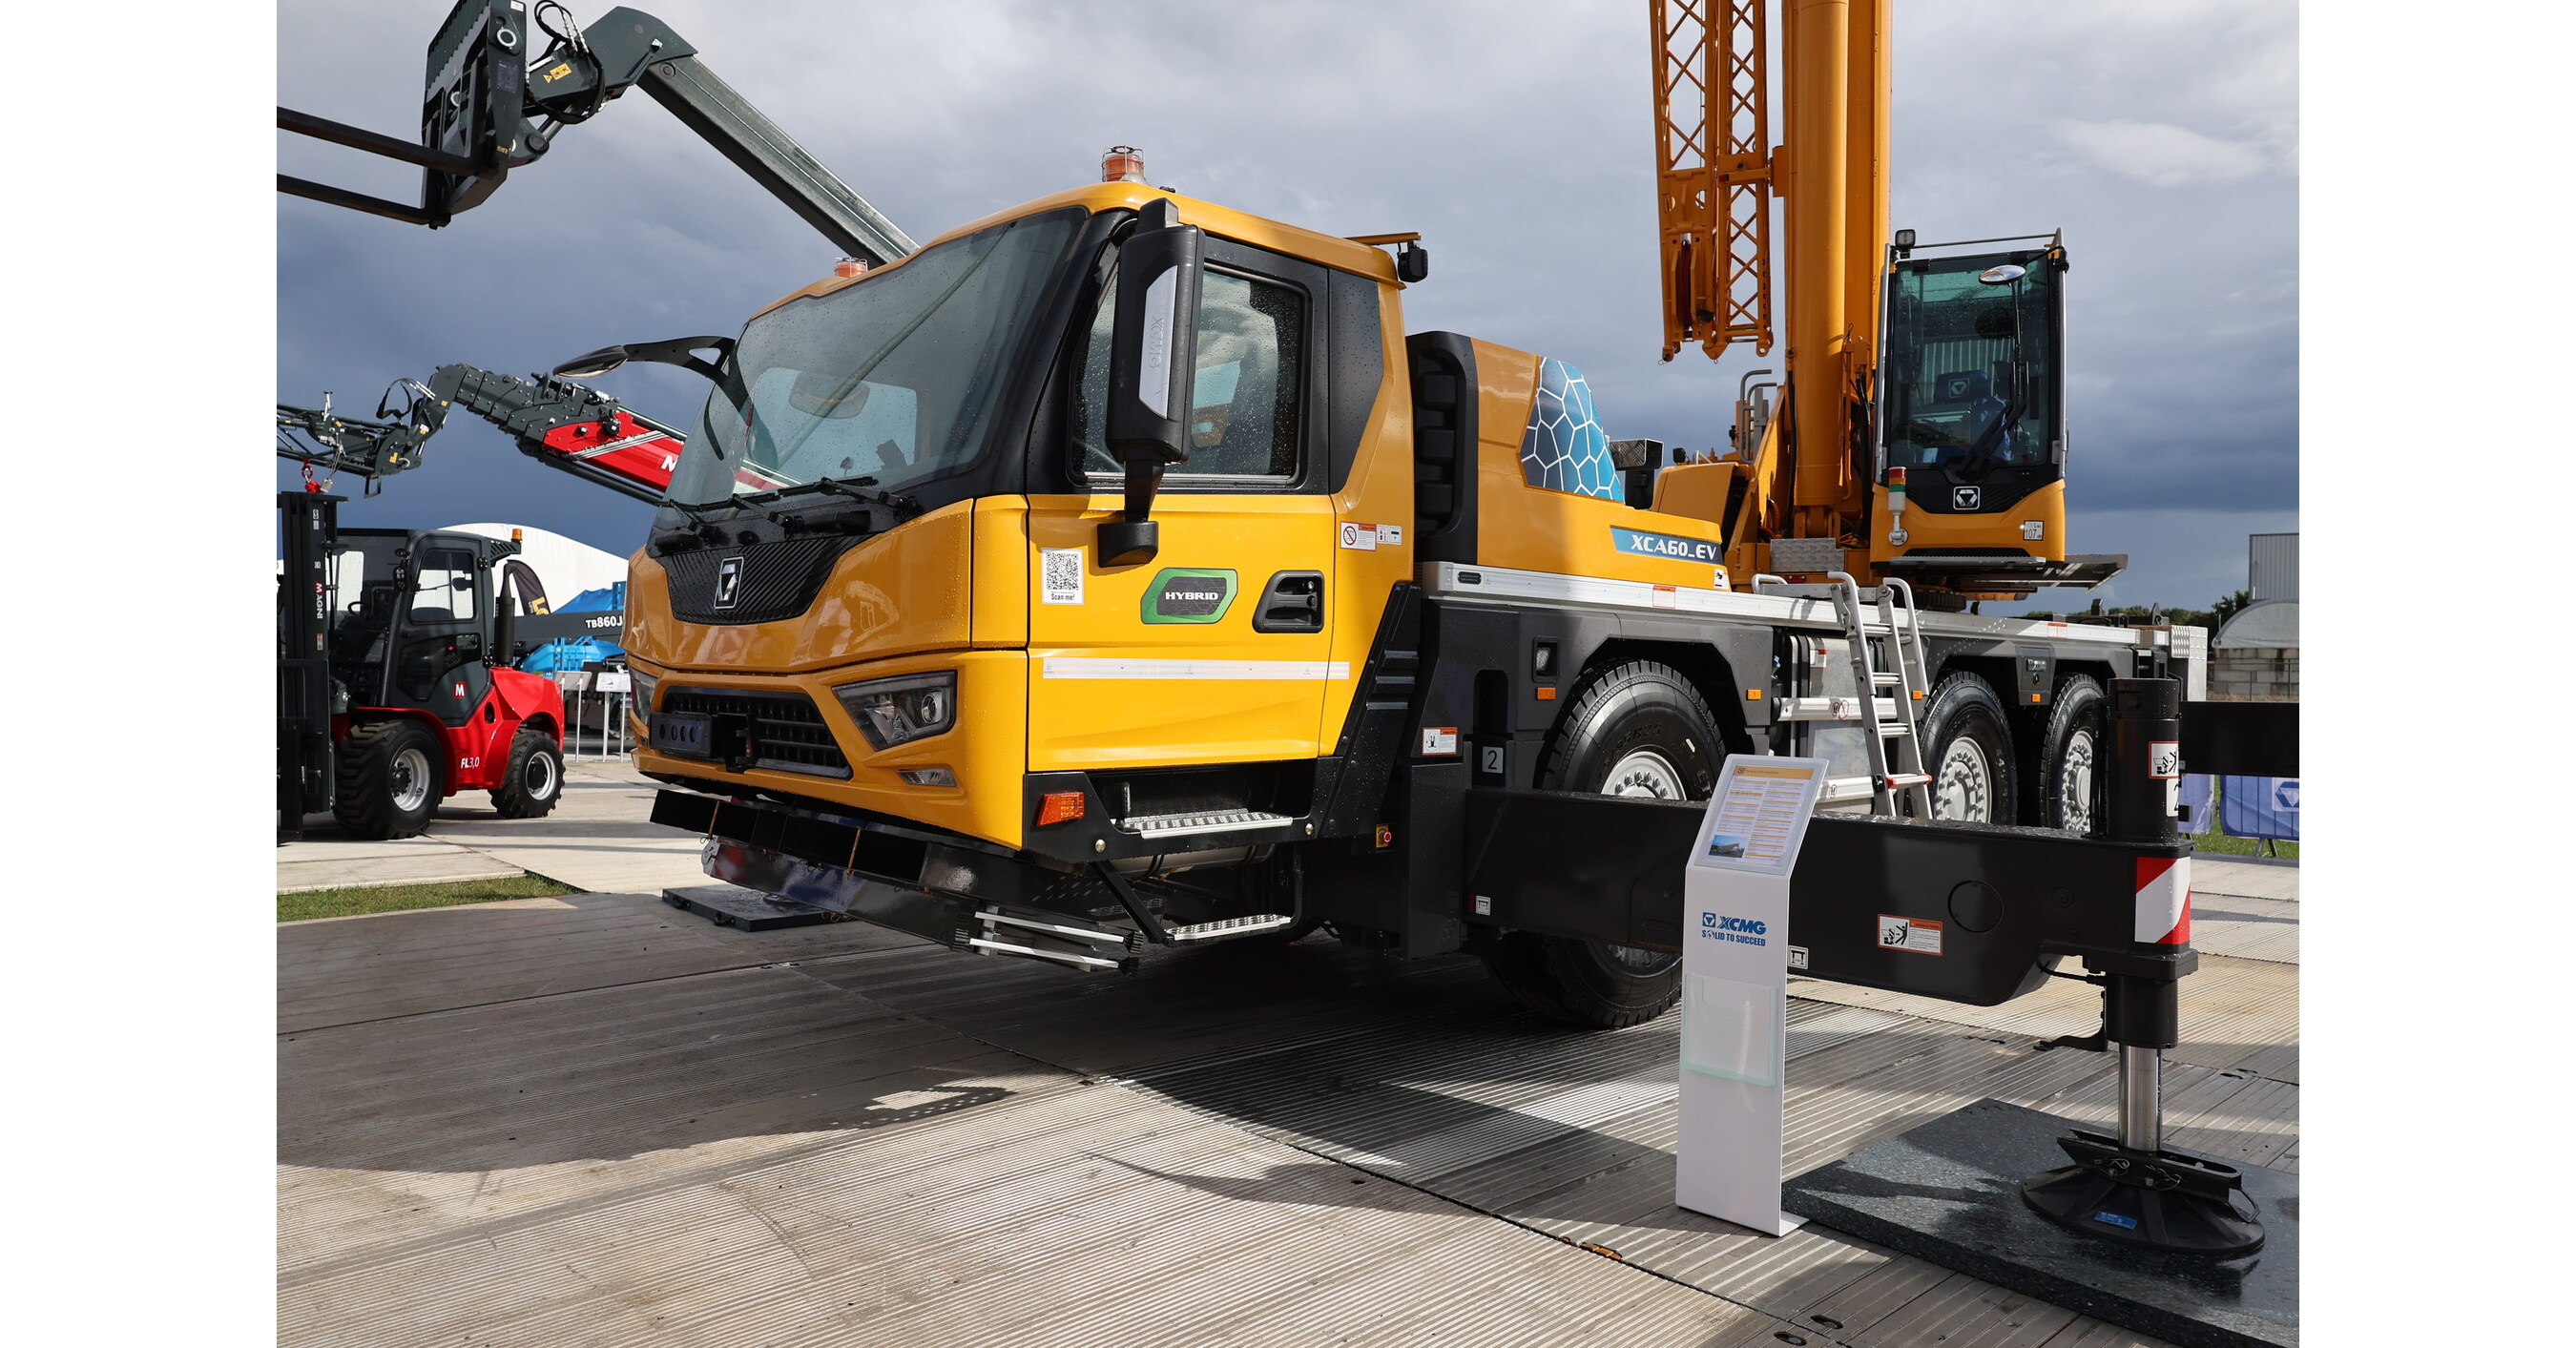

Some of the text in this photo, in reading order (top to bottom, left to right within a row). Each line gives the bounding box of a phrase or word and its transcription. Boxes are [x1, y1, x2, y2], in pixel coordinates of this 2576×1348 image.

[2025, 529, 2037, 538] 107
[1631, 534, 1717, 560] XCA60_EV
[1165, 591, 1219, 600] HYBRID
[585, 615, 623, 629] TB860J
[1487, 750, 1498, 770] 2
[1717, 916, 1767, 935] XCMG
[1726, 933, 1735, 942] TO
[1735, 935, 1766, 946] SUCCEED
